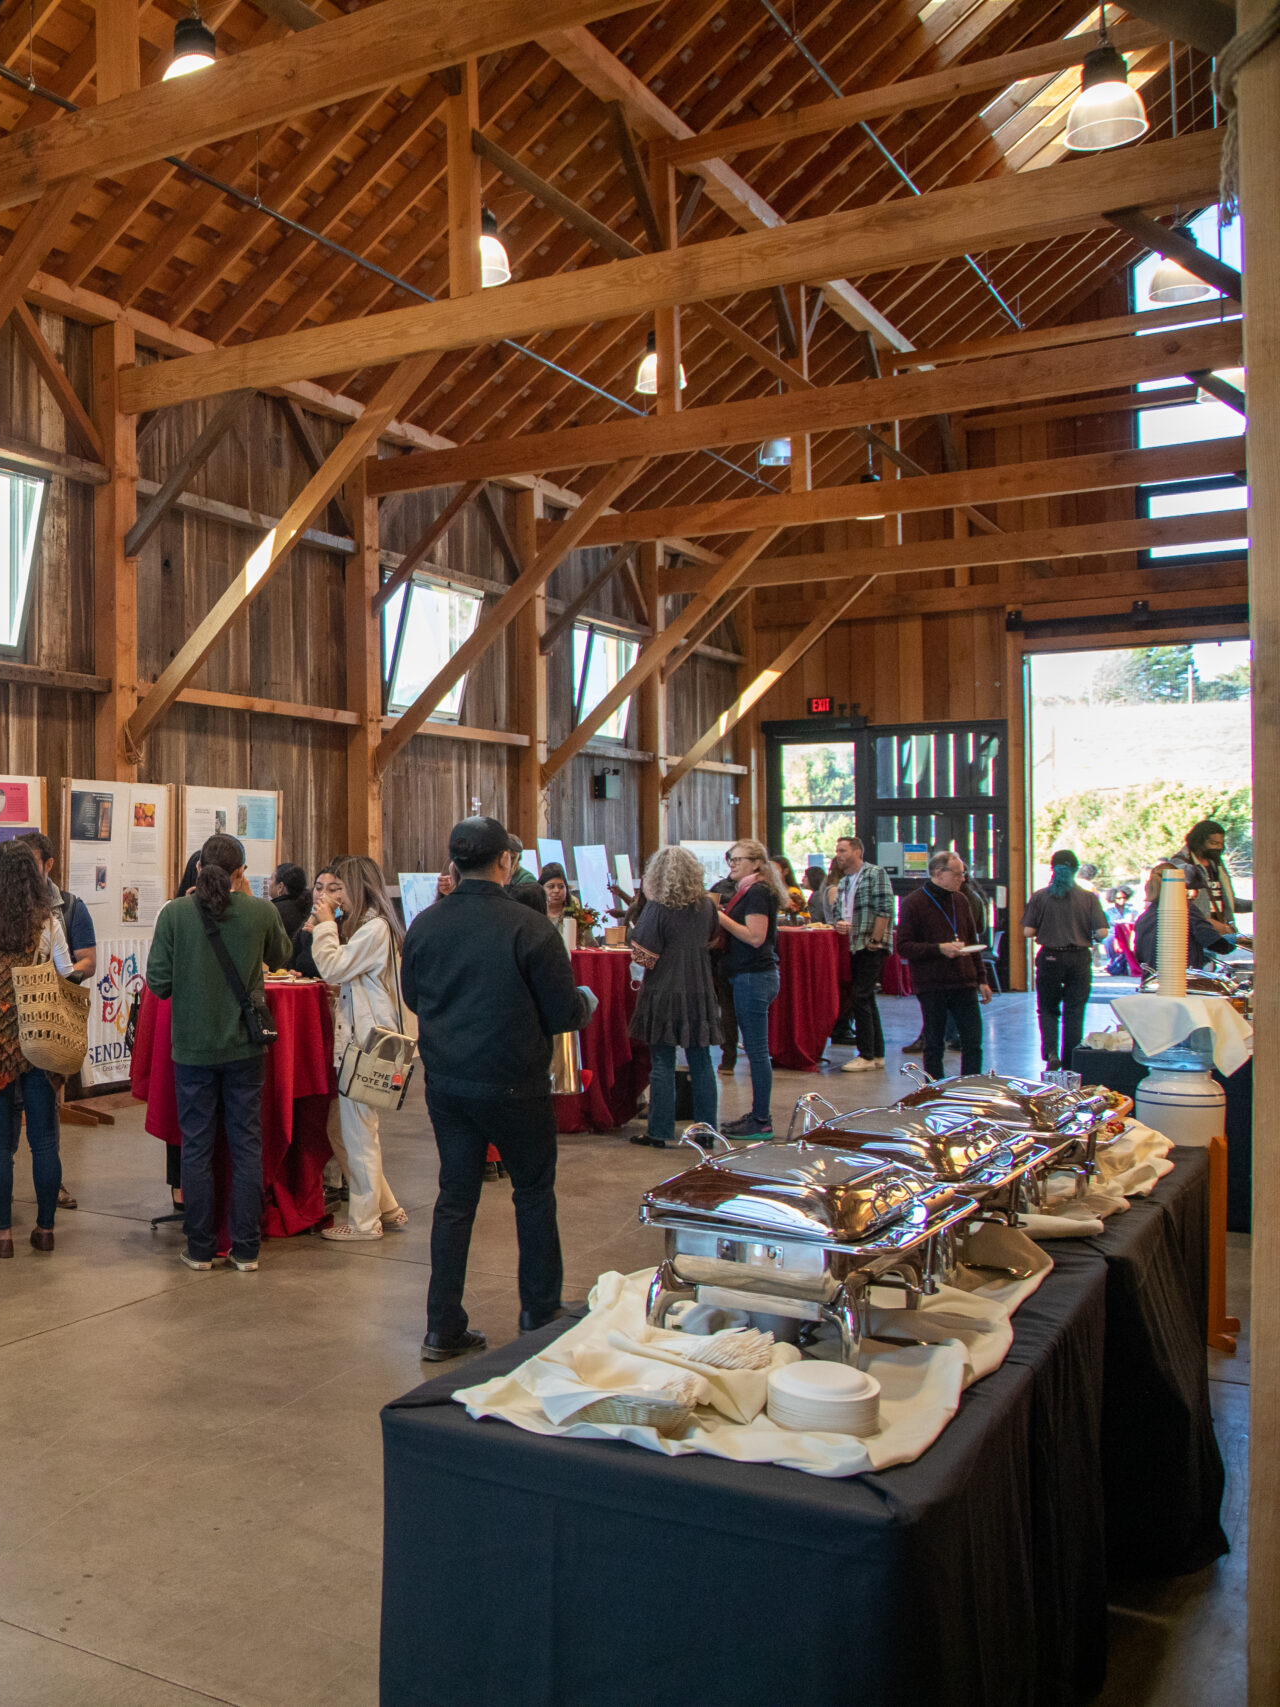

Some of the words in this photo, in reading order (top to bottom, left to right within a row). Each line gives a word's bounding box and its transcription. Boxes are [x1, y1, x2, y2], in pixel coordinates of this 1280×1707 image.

[812, 698, 830, 712] EXIT
[89, 1041, 131, 1065] SENDE
[355, 1074, 380, 1086] TOTE
[373, 1071, 391, 1080] THE
